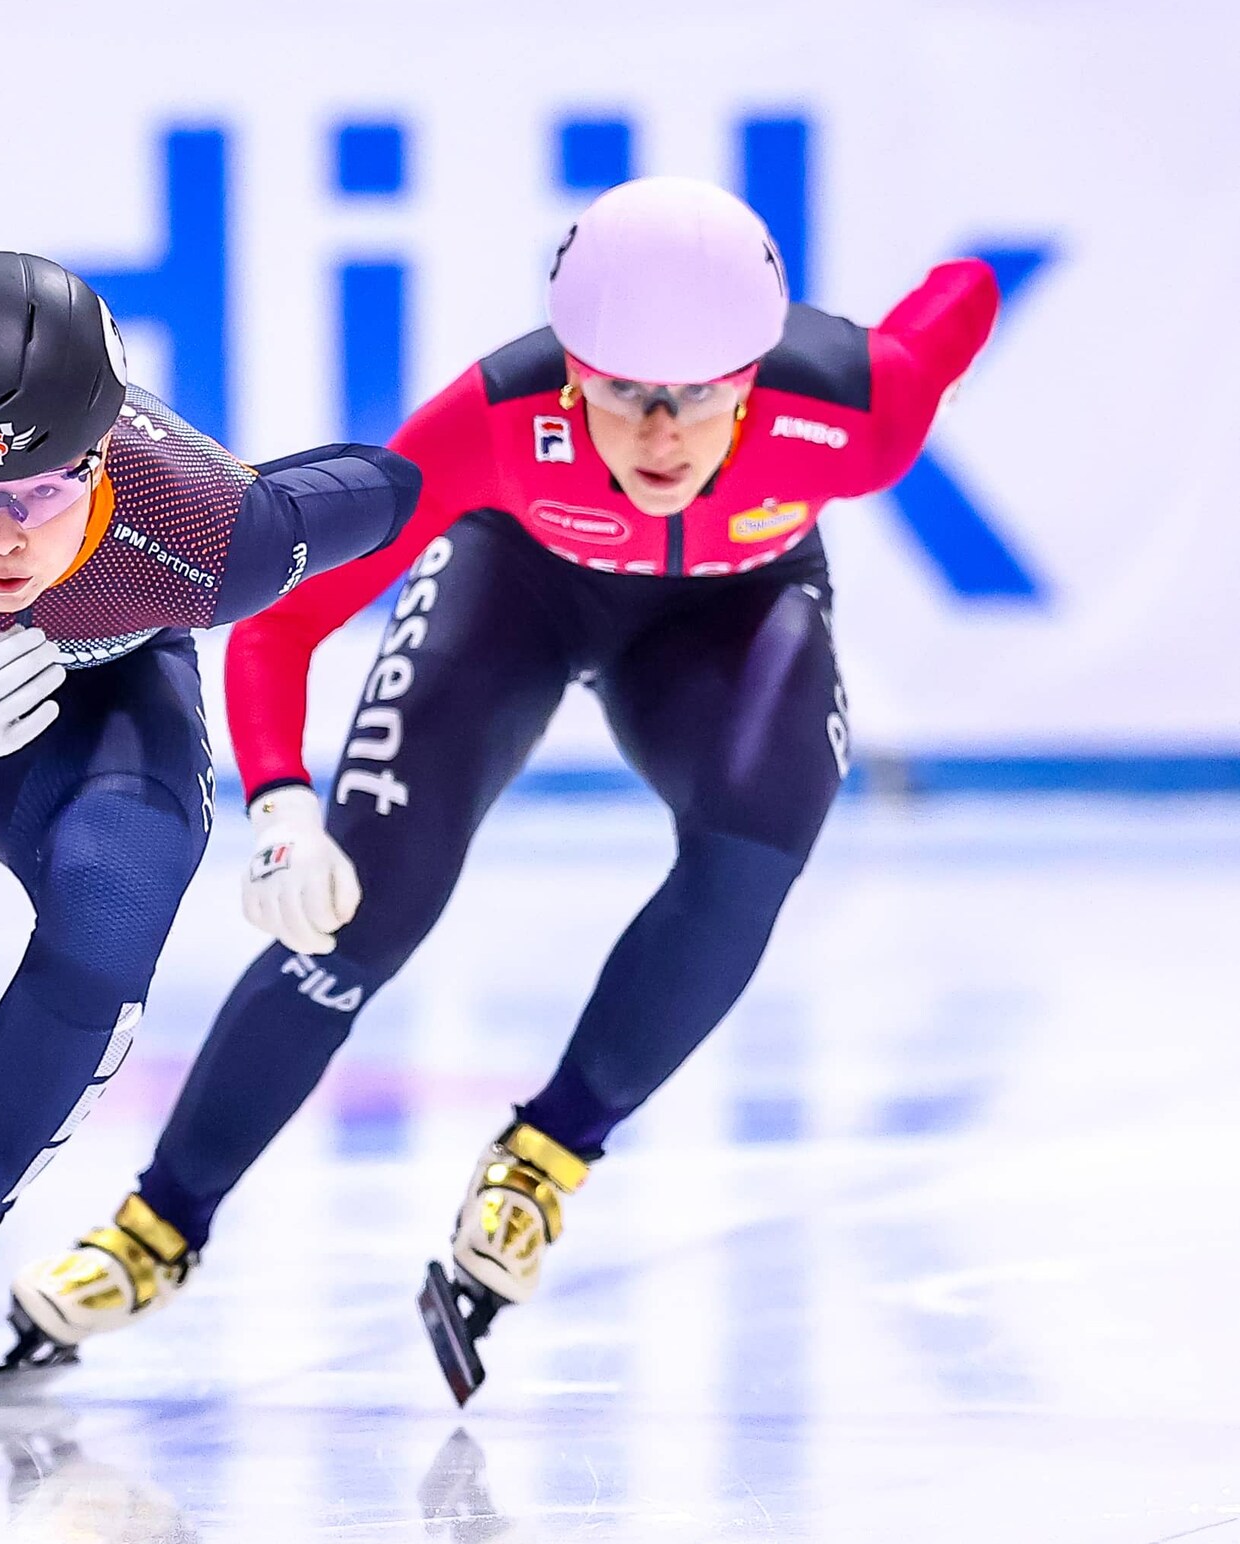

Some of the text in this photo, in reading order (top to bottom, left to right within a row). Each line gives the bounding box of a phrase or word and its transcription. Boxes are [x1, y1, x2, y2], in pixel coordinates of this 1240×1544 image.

[147, 541, 216, 589] Partners
[336, 535, 454, 816] essent
[280, 953, 365, 1012] FILA
